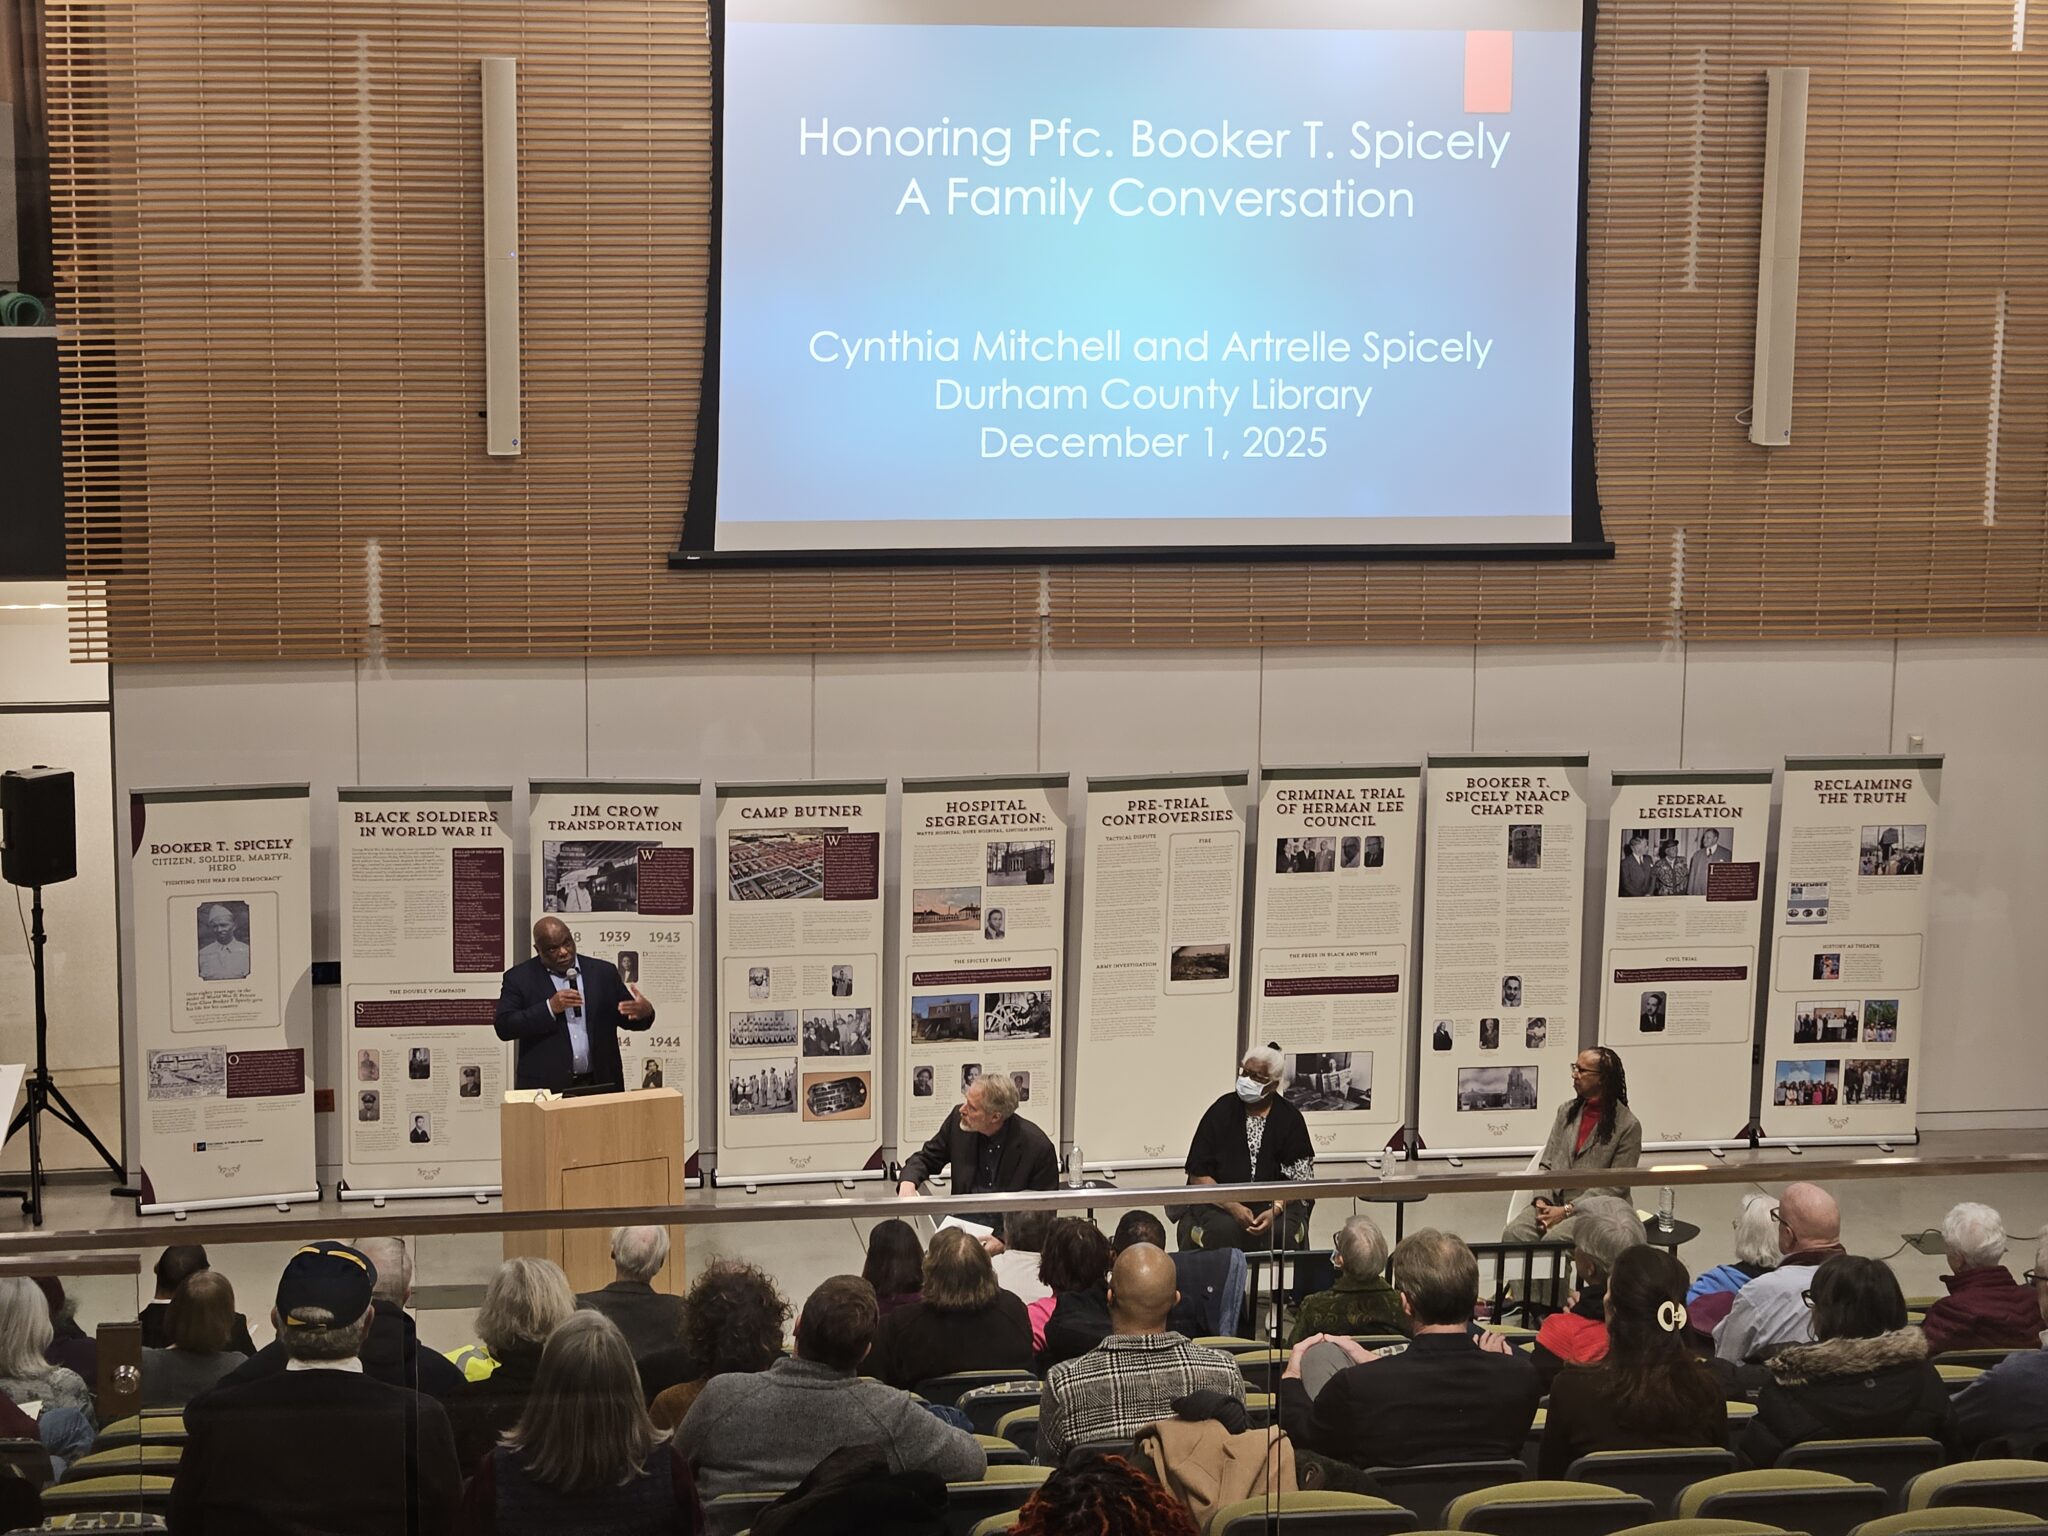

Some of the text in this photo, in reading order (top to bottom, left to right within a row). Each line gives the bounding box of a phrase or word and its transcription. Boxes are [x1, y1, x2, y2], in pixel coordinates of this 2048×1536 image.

[798, 115, 1510, 168] Honoring Pfc. Booker T. Spicely
[896, 177, 1413, 224] A Family Conversation
[810, 329, 1493, 369] Cynthia Mitchell and Artrelle Spicely
[936, 376, 1372, 417] Durham County Library
[981, 426, 1327, 460] December 1, 2025
[1467, 778, 1550, 788] BOOKER T.
[1814, 779, 1913, 791] RECLAIMING
[1276, 788, 1405, 801] CRIMINAL TRIAL
[1446, 791, 1570, 802] SPICELY NAACP
[1657, 794, 1726, 805] FEDERAL
[1818, 793, 1906, 804] THE TRUTH
[946, 800, 1026, 813] HOSPITAL
[1128, 798, 1209, 811] PRE-TRIAL
[1277, 801, 1403, 814] OF HERMAN LEE
[1471, 805, 1544, 815] CHAPTER
[354, 811, 498, 823] BLACK SOLDIERS
[571, 806, 659, 817] JIM CROW
[741, 806, 863, 819] CAMP BUTNER
[1639, 807, 1744, 819] LEGISLATION
[926, 813, 1046, 828] SEGREGATION:
[1102, 810, 1233, 826] CONTROVERSIES
[1304, 816, 1376, 827] COUNCIL
[360, 826, 492, 836] IN WORLD WAR II
[548, 821, 682, 831] TRANSPORTATION
[151, 839, 293, 854] BOOKER T. SPICELY
[152, 853, 292, 866] CITIZEN, SOLDIER, MARTYR,
[209, 864, 237, 872] HERO
[600, 932, 631, 942] 1939
[649, 932, 680, 943] 1943
[618, 1036, 631, 1047] 14
[650, 1036, 680, 1047] 1944
